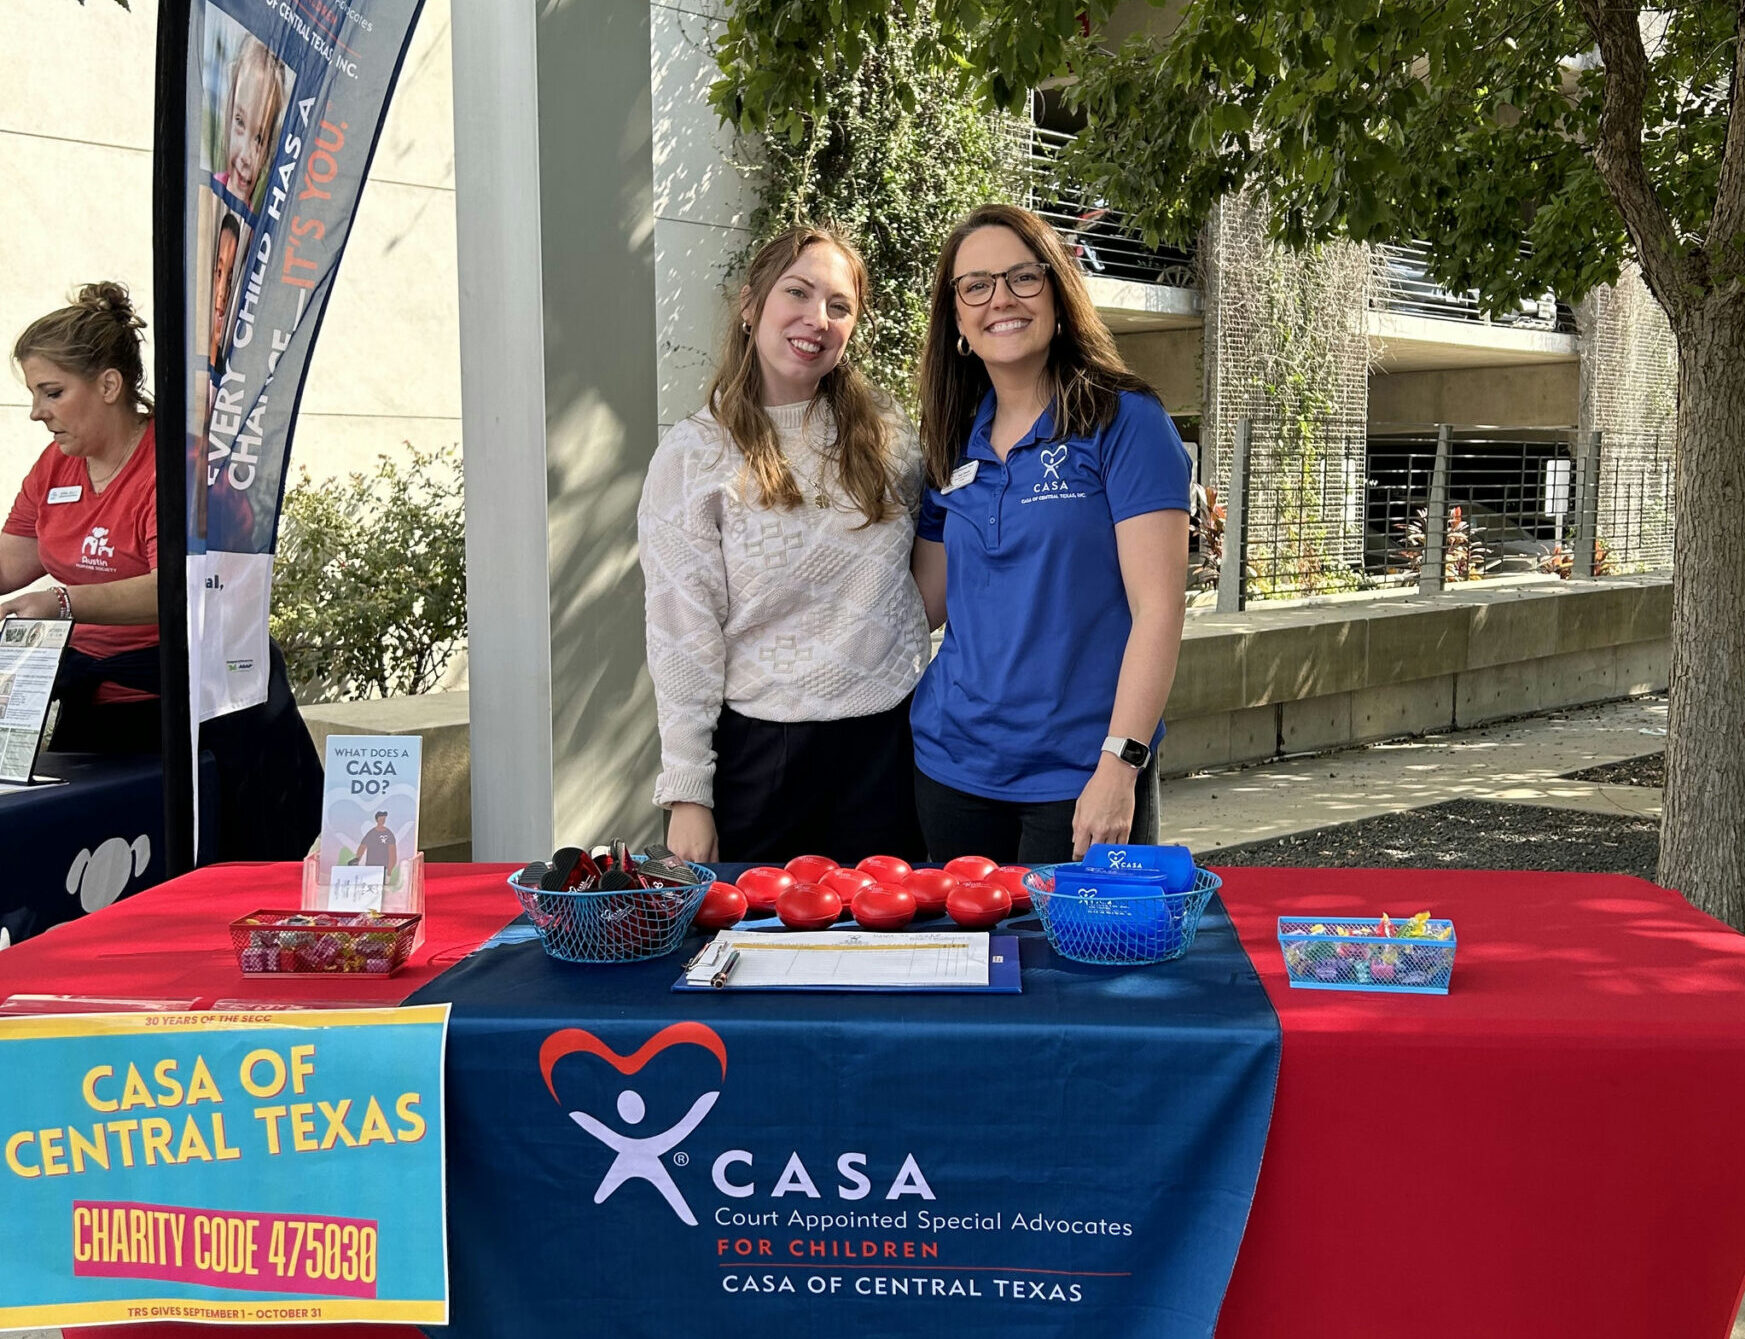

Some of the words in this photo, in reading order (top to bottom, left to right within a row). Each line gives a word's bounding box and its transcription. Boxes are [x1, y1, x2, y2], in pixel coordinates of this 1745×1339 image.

[280, 2, 310, 41] CENTRAL
[310, 32, 334, 65] TEXAS,
[335, 55, 358, 80] INC.
[300, 120, 348, 200] YOU.
[233, 232, 271, 349] CHILD
[267, 133, 302, 221] HAS
[298, 97, 316, 127] A
[1033, 481, 1068, 493] CASA
[82, 556, 108, 567] Austin
[335, 748, 368, 757] WHAT
[370, 748, 399, 758] DOES
[401, 749, 409, 758] A
[346, 760, 397, 776] CASA
[351, 779, 390, 795] DO?
[1120, 861, 1142, 869] CASA
[145, 1016, 159, 1026] 30
[162, 1016, 198, 1026] YEARS
[200, 1015, 216, 1024] OF
[219, 1014, 239, 1023] THE
[241, 1014, 272, 1023] SECC
[82, 1054, 224, 1113] CASA
[240, 1044, 316, 1098] OF
[5, 1112, 241, 1178] CENTRAL
[254, 1092, 427, 1155] TEXAS
[711, 1149, 937, 1201] CASA
[714, 1206, 779, 1227] Court
[787, 1208, 907, 1232] Appointed
[918, 1210, 1001, 1233] Special
[1011, 1212, 1133, 1236] Advocates
[73, 1207, 186, 1267] CHARITY
[193, 1215, 260, 1275] CODE
[268, 1221, 377, 1284] 475030
[717, 1238, 773, 1256] FOR
[789, 1239, 938, 1259] CHILDREN
[722, 1274, 796, 1294] CASA
[807, 1275, 843, 1294] OF
[855, 1276, 982, 1298] CENTRAL
[993, 1279, 1082, 1302] TEXAS
[128, 1307, 148, 1317] TRS
[151, 1306, 182, 1316] GIVES
[183, 1308, 239, 1319] SEPTEMBER
[240, 1309, 246, 1318] 1
[255, 1308, 309, 1319] OCTOBER
[311, 1308, 322, 1318] 31
